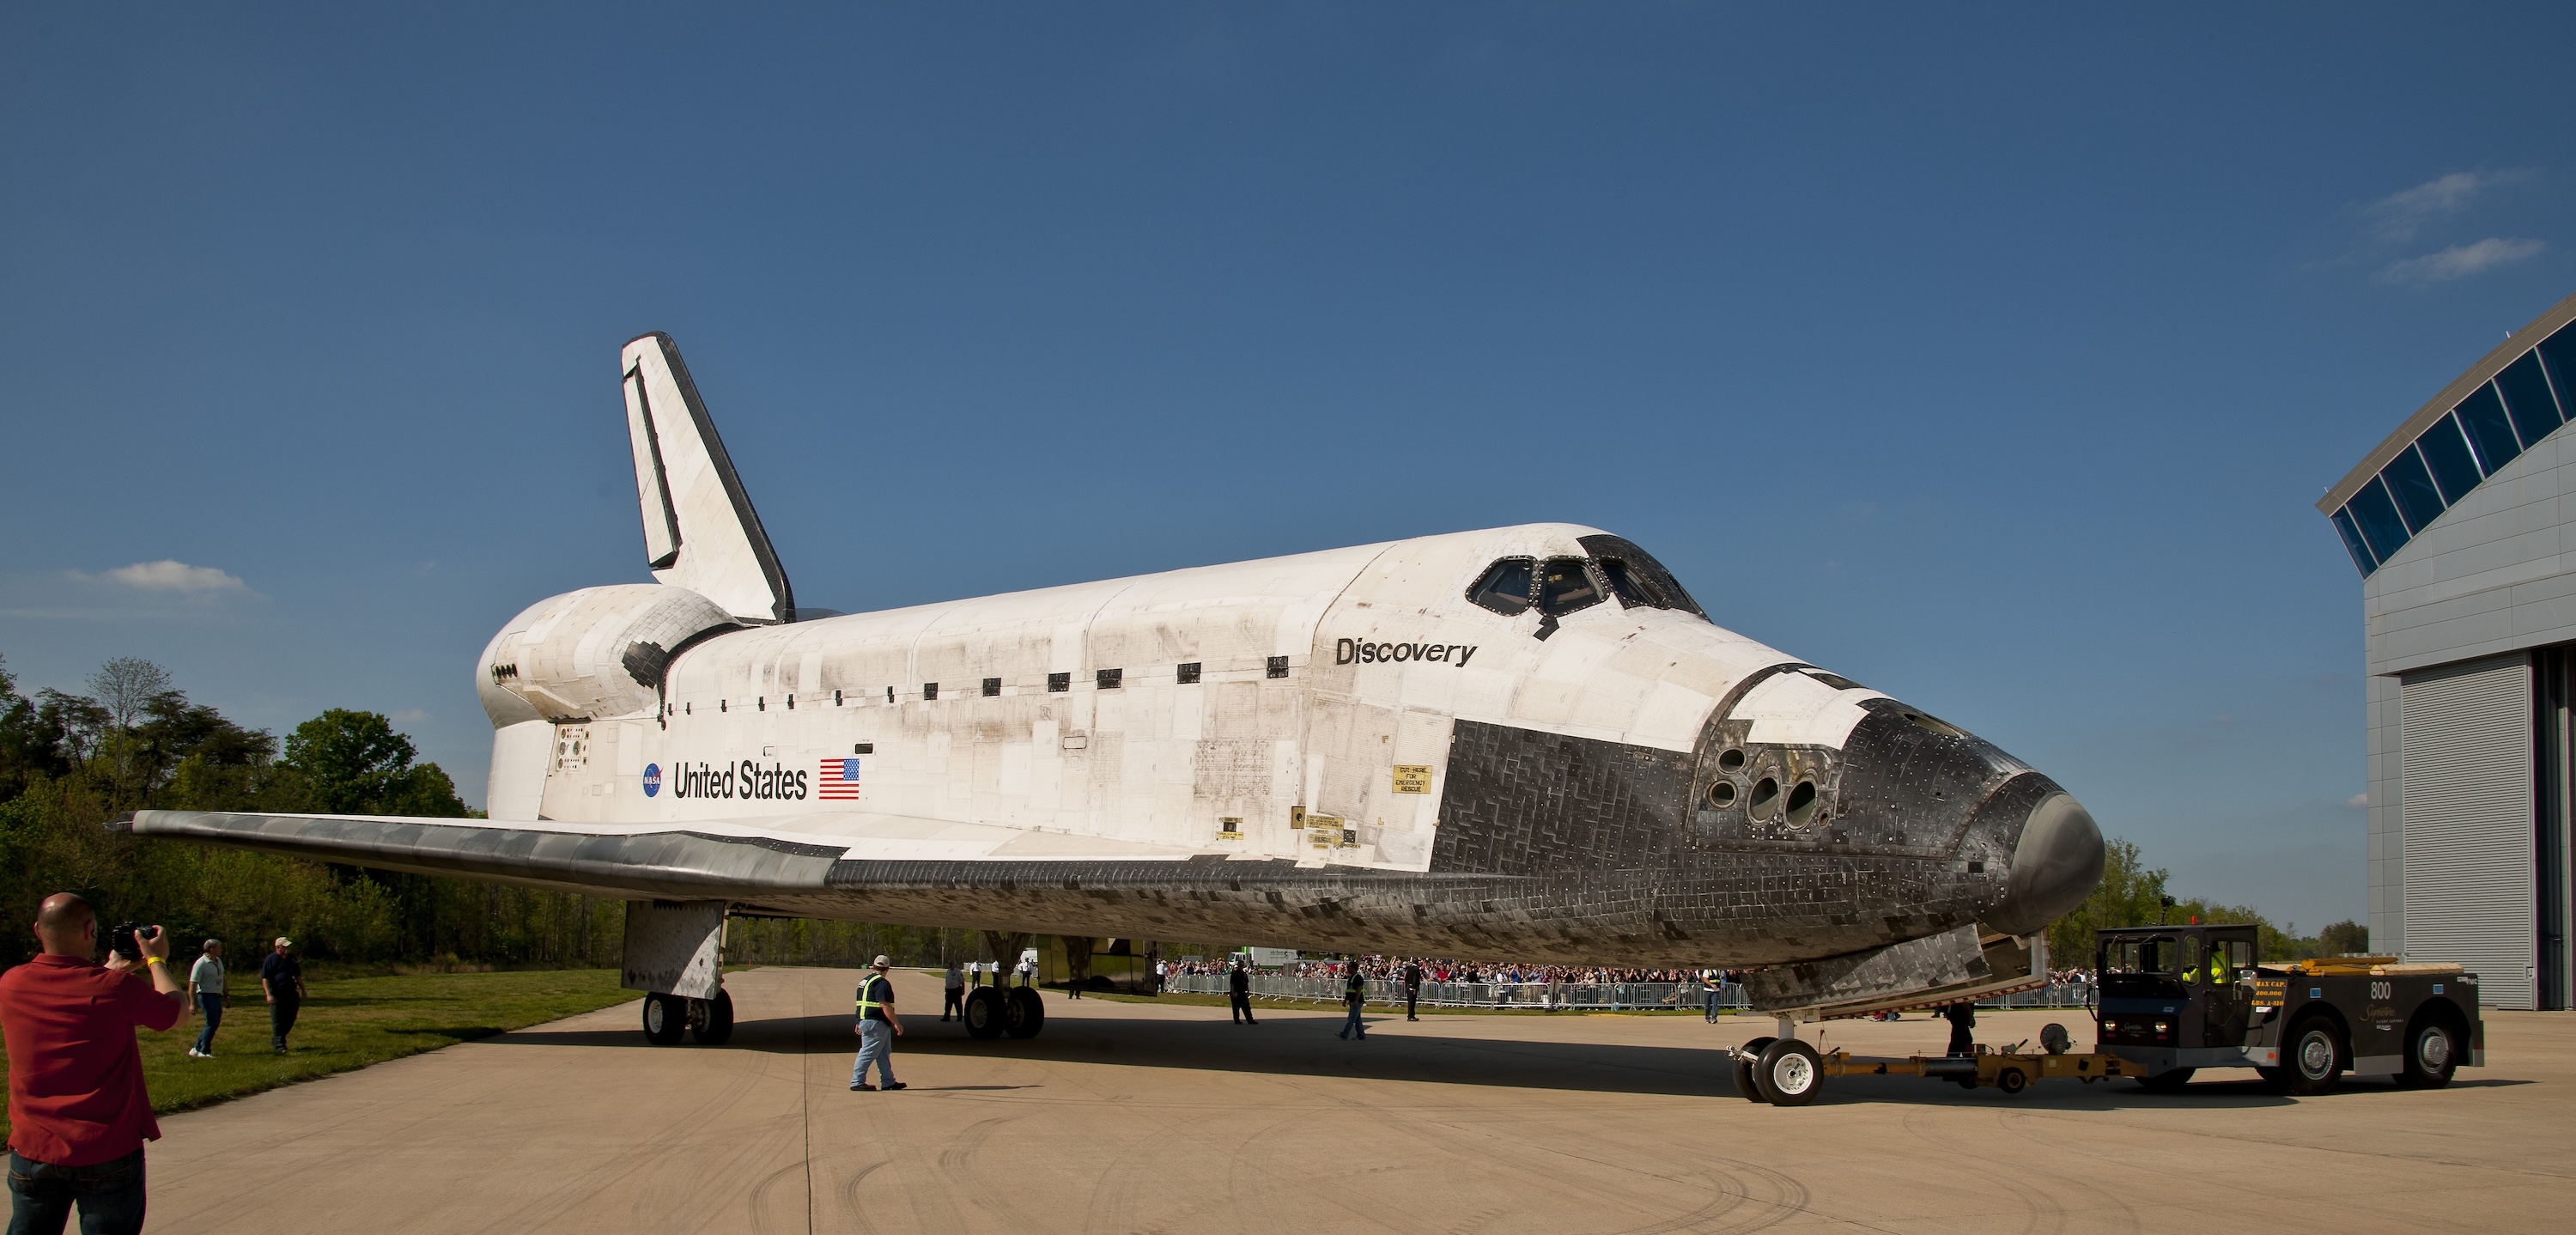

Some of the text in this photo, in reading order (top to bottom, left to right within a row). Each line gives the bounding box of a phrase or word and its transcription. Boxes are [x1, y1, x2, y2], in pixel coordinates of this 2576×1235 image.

[1336, 638, 1479, 668] Discovery
[644, 776, 660, 785] NASA
[674, 759, 807, 800] United States
[2371, 981, 2391, 1000] 800
